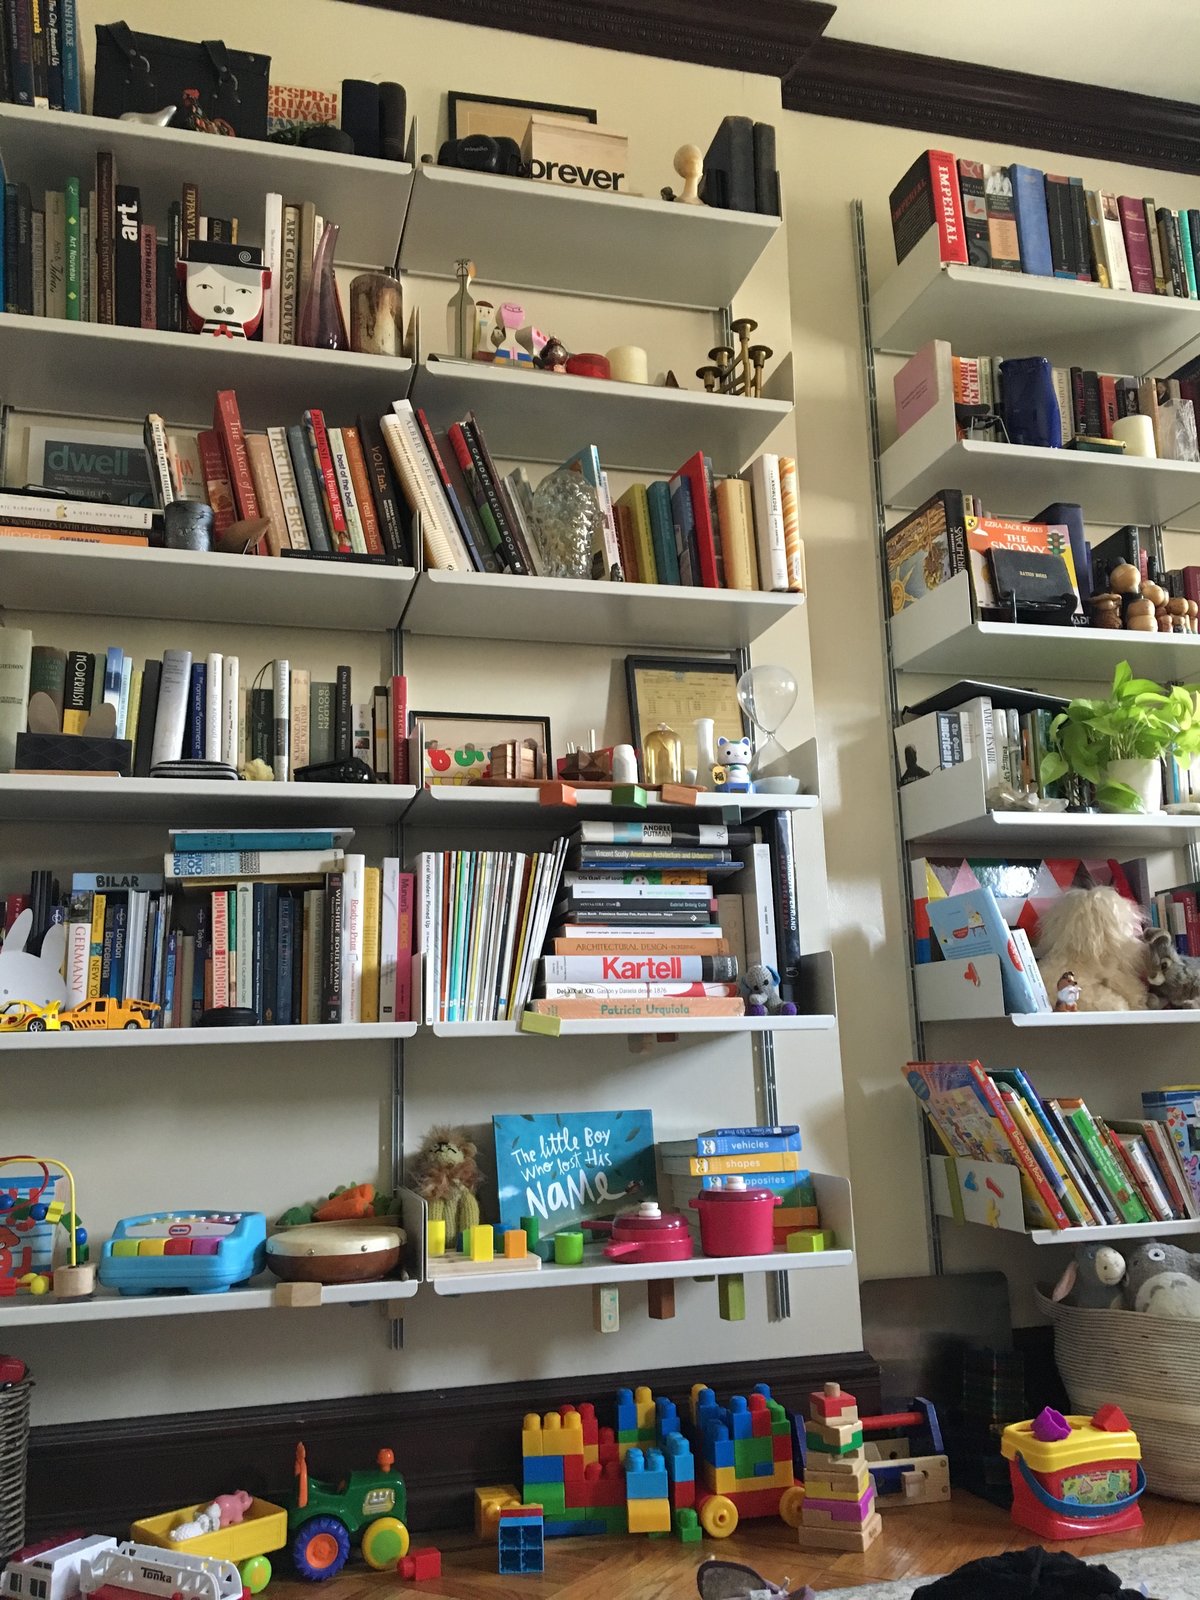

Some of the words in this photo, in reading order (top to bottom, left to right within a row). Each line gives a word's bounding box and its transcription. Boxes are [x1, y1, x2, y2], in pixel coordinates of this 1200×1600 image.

[48, 13, 58, 27] City
[65, 19, 75, 48] HOUSE
[50, 27, 59, 57] Beneath
[51, 57, 60, 67] Us
[186, 189, 197, 226] TIFFANY
[940, 166, 959, 244] IMPERIAL
[101, 206, 109, 243] AMERICAN
[118, 201, 139, 242] art
[285, 219, 296, 246] ART
[69, 236, 77, 247] Art
[144, 234, 152, 258] KEITH
[69, 249, 77, 282] Nouveau
[102, 246, 110, 281] PAINTING
[144, 260, 152, 289] HARING
[284, 248, 295, 291] GLASS
[49, 261, 64, 294] Ideas
[282, 293, 294, 345] NOUVEA
[969, 361, 979, 386] THE
[229, 420, 241, 441] THE
[312, 413, 325, 440] JOHN
[48, 445, 129, 477] dwell
[158, 453, 166, 473] TWENTY
[234, 444, 247, 478] MAGIC
[318, 440, 329, 460] BESH
[336, 454, 347, 471] best
[403, 420, 421, 455] ALBERT
[418, 457, 437, 488] SPEER
[272, 429, 298, 500] TARTINE
[324, 468, 335, 480] My
[239, 480, 254, 490] of
[303, 468, 318, 501] GENIUS
[327, 480, 340, 502] Family
[343, 480, 352, 491] the
[462, 424, 473, 443] THE
[470, 447, 491, 487] GARDEN
[486, 490, 506, 526] DESIGN
[504, 530, 518, 557] BOOK
[770, 479, 779, 512] KNOWLEDGE
[243, 492, 258, 518] FIRE
[332, 502, 343, 522] Table
[344, 491, 355, 508] best
[362, 501, 374, 519] real
[382, 499, 391, 521] MICHAEL
[308, 502, 325, 539] RECIPES
[984, 521, 1003, 531] EZRA
[1004, 523, 1022, 533] JACK
[1022, 525, 1044, 536] KEATS
[58, 536, 102, 544] GERMANY
[365, 519, 380, 552] kitchen
[953, 526, 966, 571] IRTHDAYS
[1003, 532, 1029, 543] THE
[73, 654, 87, 706] MODERNISM
[279, 662, 287, 692] LILLIAN
[194, 683, 205, 712] romance
[279, 695, 287, 715] ROSS
[316, 689, 325, 730] BOUGH
[323, 689, 331, 730] GOLDEN
[293, 706, 301, 722] LOST
[194, 716, 204, 750] commerce
[293, 723, 301, 761] GENERATION
[940, 717, 953, 761] american
[1001, 745, 1010, 770] Falling
[1003, 771, 1011, 782] Up
[643, 830, 672, 838] PUTMAN
[173, 852, 182, 876] ONE
[186, 852, 195, 876] FOR
[425, 854, 433, 872] Marcel
[595, 849, 614, 858] Vincent
[614, 849, 631, 860] Scully
[630, 850, 653, 858] American
[653, 851, 682, 860] Architecture
[95, 875, 140, 888] BILAR
[424, 873, 432, 900] Wanders:
[400, 878, 411, 914] Munari's
[780, 872, 790, 930] photography
[214, 895, 227, 951] HOLLYWOOD
[281, 899, 290, 923] BLUE
[334, 889, 342, 934] WILSHIRE
[347, 899, 359, 922] Ready
[424, 900, 433, 920] Pinned
[114, 927, 125, 959] London
[196, 928, 206, 949] Tokyo
[349, 932, 359, 951] Print
[400, 914, 409, 950] BOOKS
[71, 925, 88, 994] GERMANY
[102, 930, 114, 979] Barcelona
[281, 926, 291, 977] LATITUDES
[575, 943, 640, 952] ARCHITECTURAL
[640, 943, 668, 952] DESIGN
[90, 959, 99, 982] NEW
[167, 957, 175, 978] VENICE
[333, 935, 342, 993] BOULEVARD
[602, 957, 682, 980] Kartell
[214, 954, 227, 1007] HANDBOOK
[556, 988, 567, 997] Del
[653, 988, 668, 997] 1876
[600, 1003, 641, 1016] Patricia
[645, 1003, 690, 1017] Urquiola
[510, 1146, 537, 1168] The
[539, 1125, 580, 1156] little
[584, 1128, 612, 1149] Boy
[730, 1139, 771, 1150] vehicles
[1011, 1130, 1026, 1150] Elmo's
[1020, 1150, 1037, 1169] Potty
[1029, 1168, 1045, 1184] Book
[520, 1159, 554, 1184] Who
[559, 1152, 583, 1177] lost
[584, 1152, 613, 1174] His
[724, 1158, 761, 1170] shapes
[140, 1566, 172, 1584] Tonka
